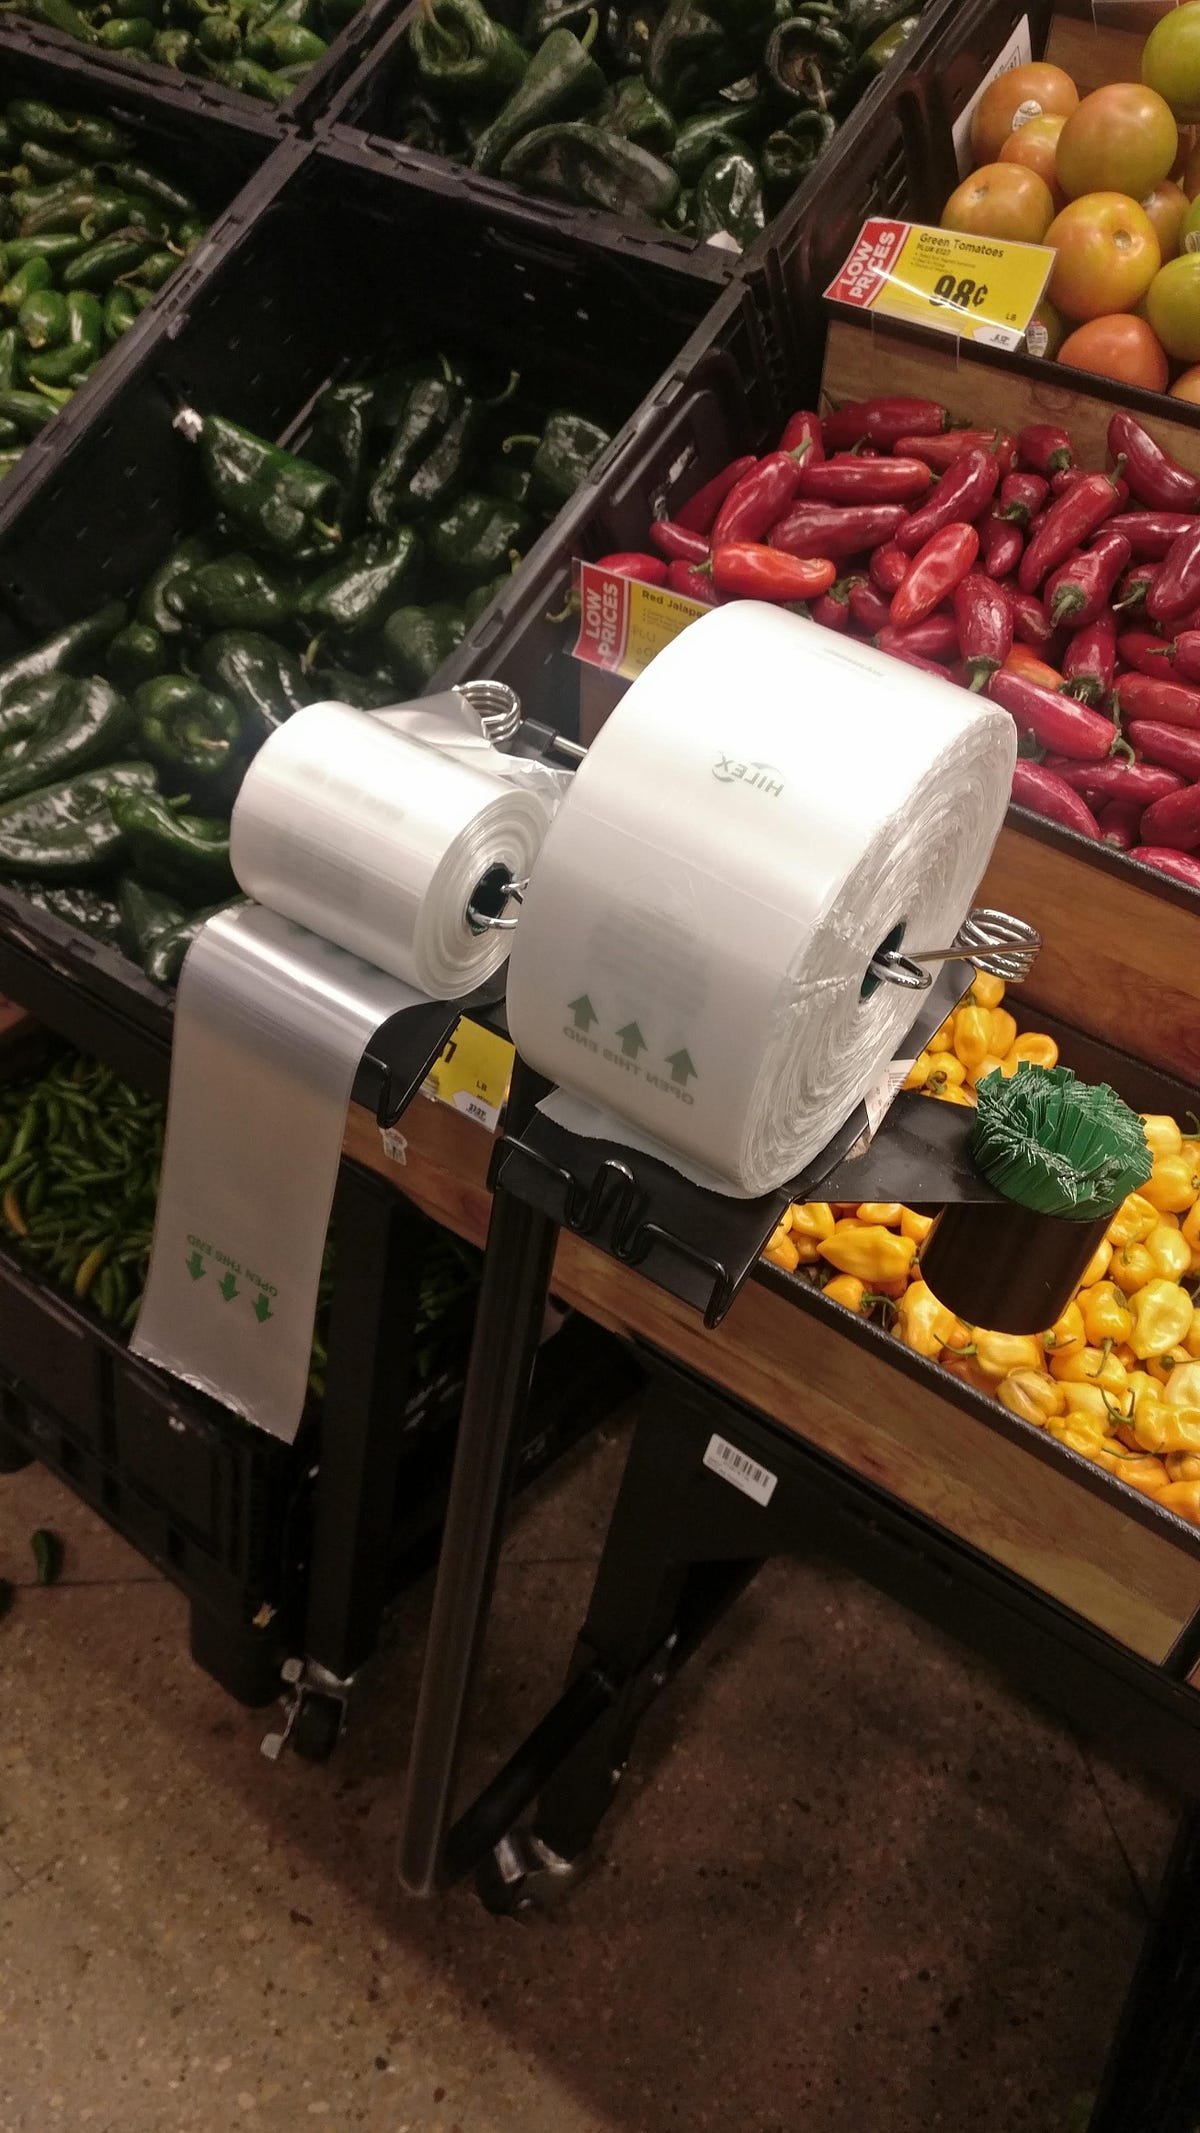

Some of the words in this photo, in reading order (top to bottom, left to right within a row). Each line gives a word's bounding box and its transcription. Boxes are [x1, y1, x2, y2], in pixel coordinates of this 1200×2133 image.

[920, 232, 950, 247] Green
[954, 239, 1004, 258] Tomatoes
[839, 240, 873, 285] LOW
[848, 231, 895, 299] PRICES
[929, 274, 988, 312] 98¢
[1005, 313, 1017, 321] LB
[642, 589, 664, 605] Red
[586, 586, 601, 639] LOW
[598, 582, 618, 658] PRICES
[475, 1080, 488, 1092] LB
[187, 1234, 212, 1256] END
[215, 1250, 242, 1275] THIS
[245, 1269, 278, 1297] OPEN
